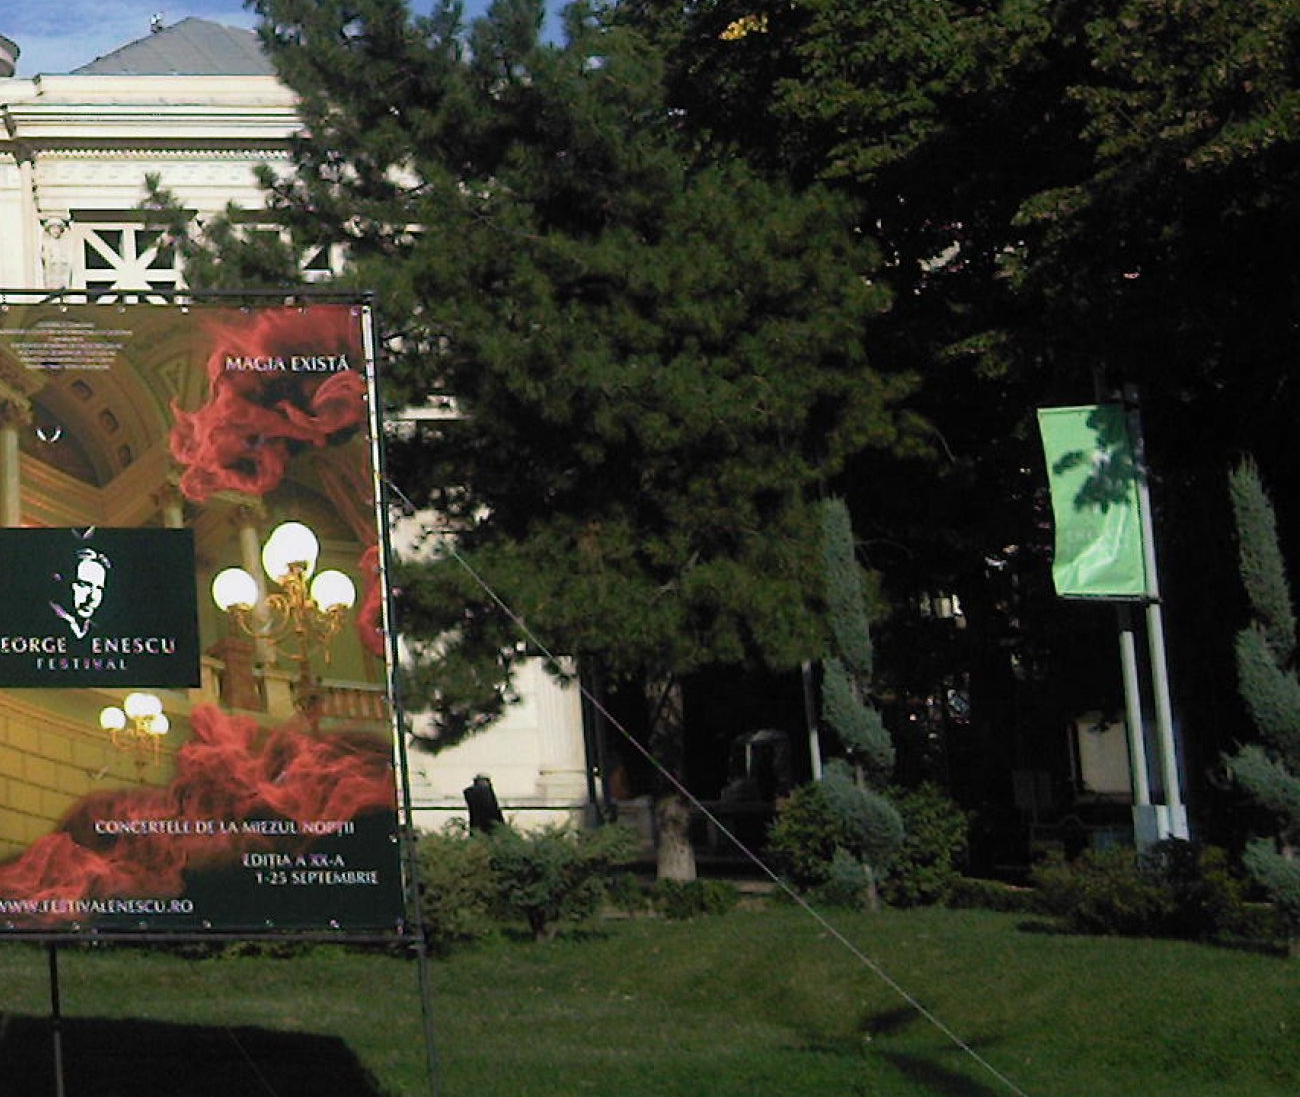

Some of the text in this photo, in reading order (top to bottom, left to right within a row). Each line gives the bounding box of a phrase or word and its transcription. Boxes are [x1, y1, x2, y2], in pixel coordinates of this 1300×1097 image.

[225, 355, 286, 372] MAGIA
[91, 636, 177, 654] ENESCU
[36, 658, 128, 671] FESTIVAL
[196, 820, 215, 835] DE
[220, 821, 239, 835] LA
[291, 870, 379, 886] SEPTEMBRIE
